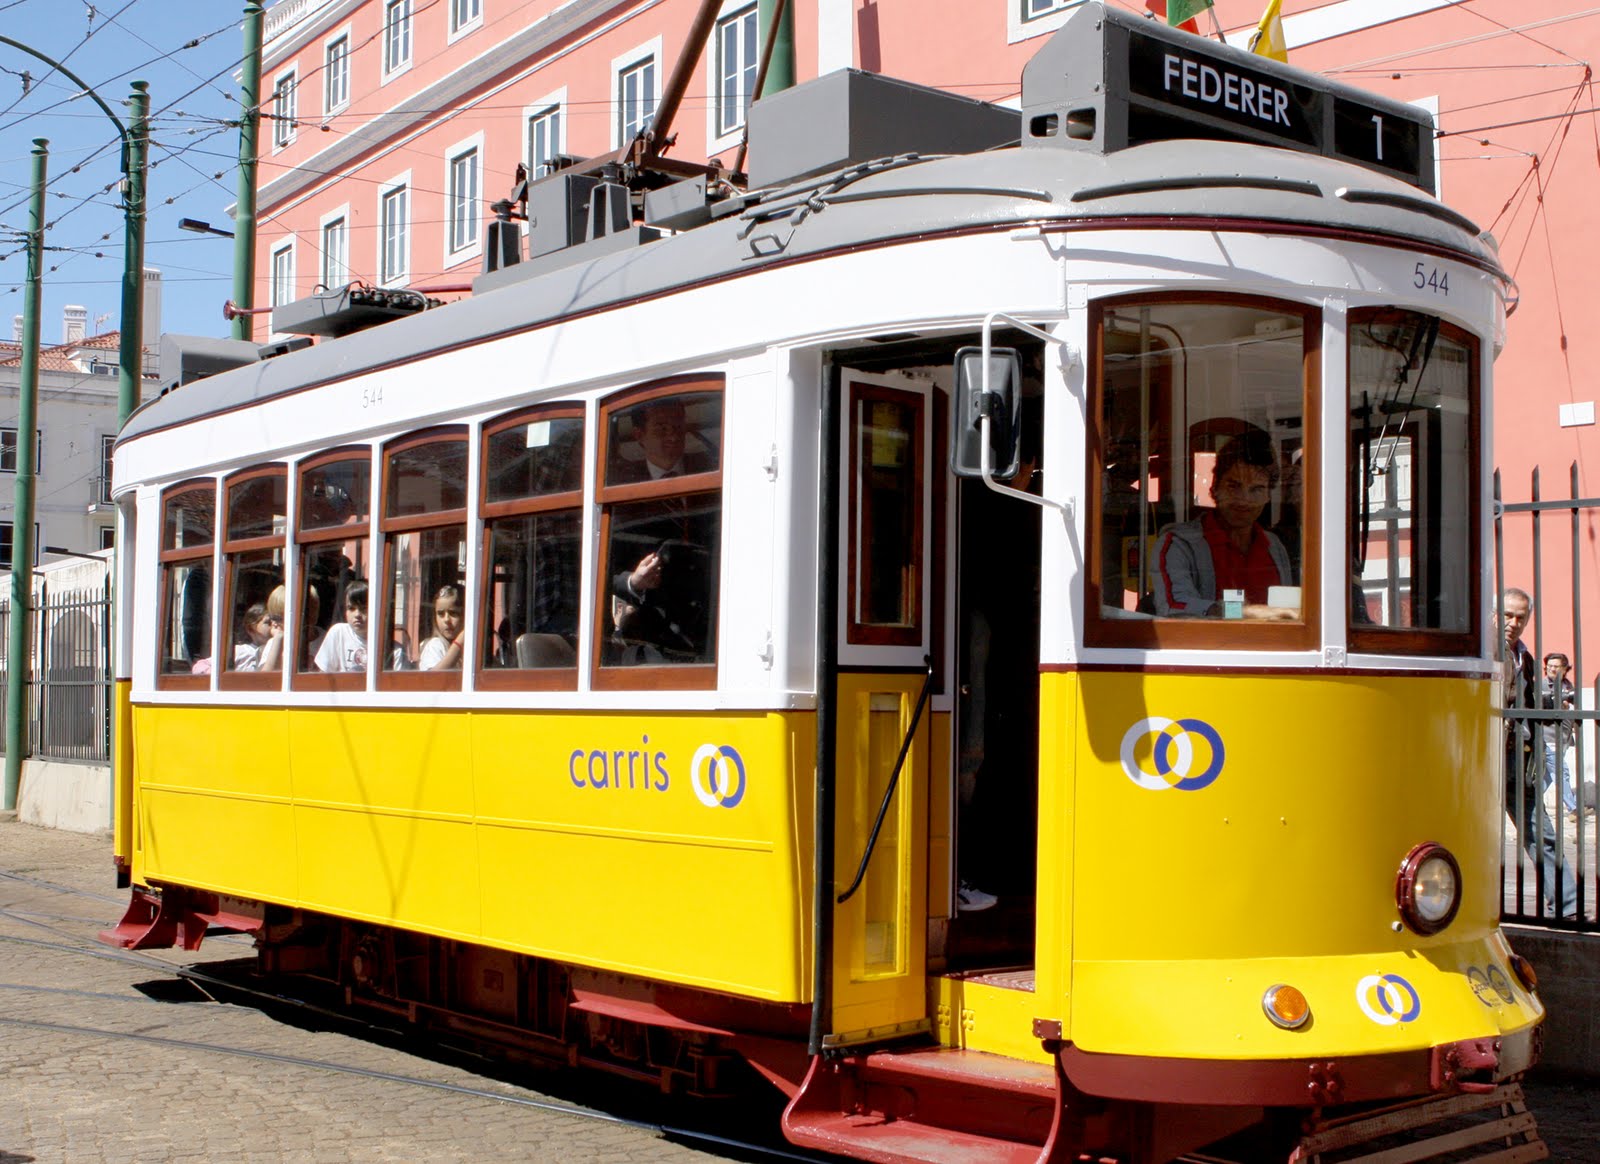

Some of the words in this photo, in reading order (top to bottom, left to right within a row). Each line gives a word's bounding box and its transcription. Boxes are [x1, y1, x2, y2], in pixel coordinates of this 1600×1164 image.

[1163, 53, 1291, 127] FEDERER
[1371, 114, 1383, 160] 1
[1413, 261, 1450, 297] 544
[362, 385, 383, 409] 544
[569, 734, 670, 792] carris
